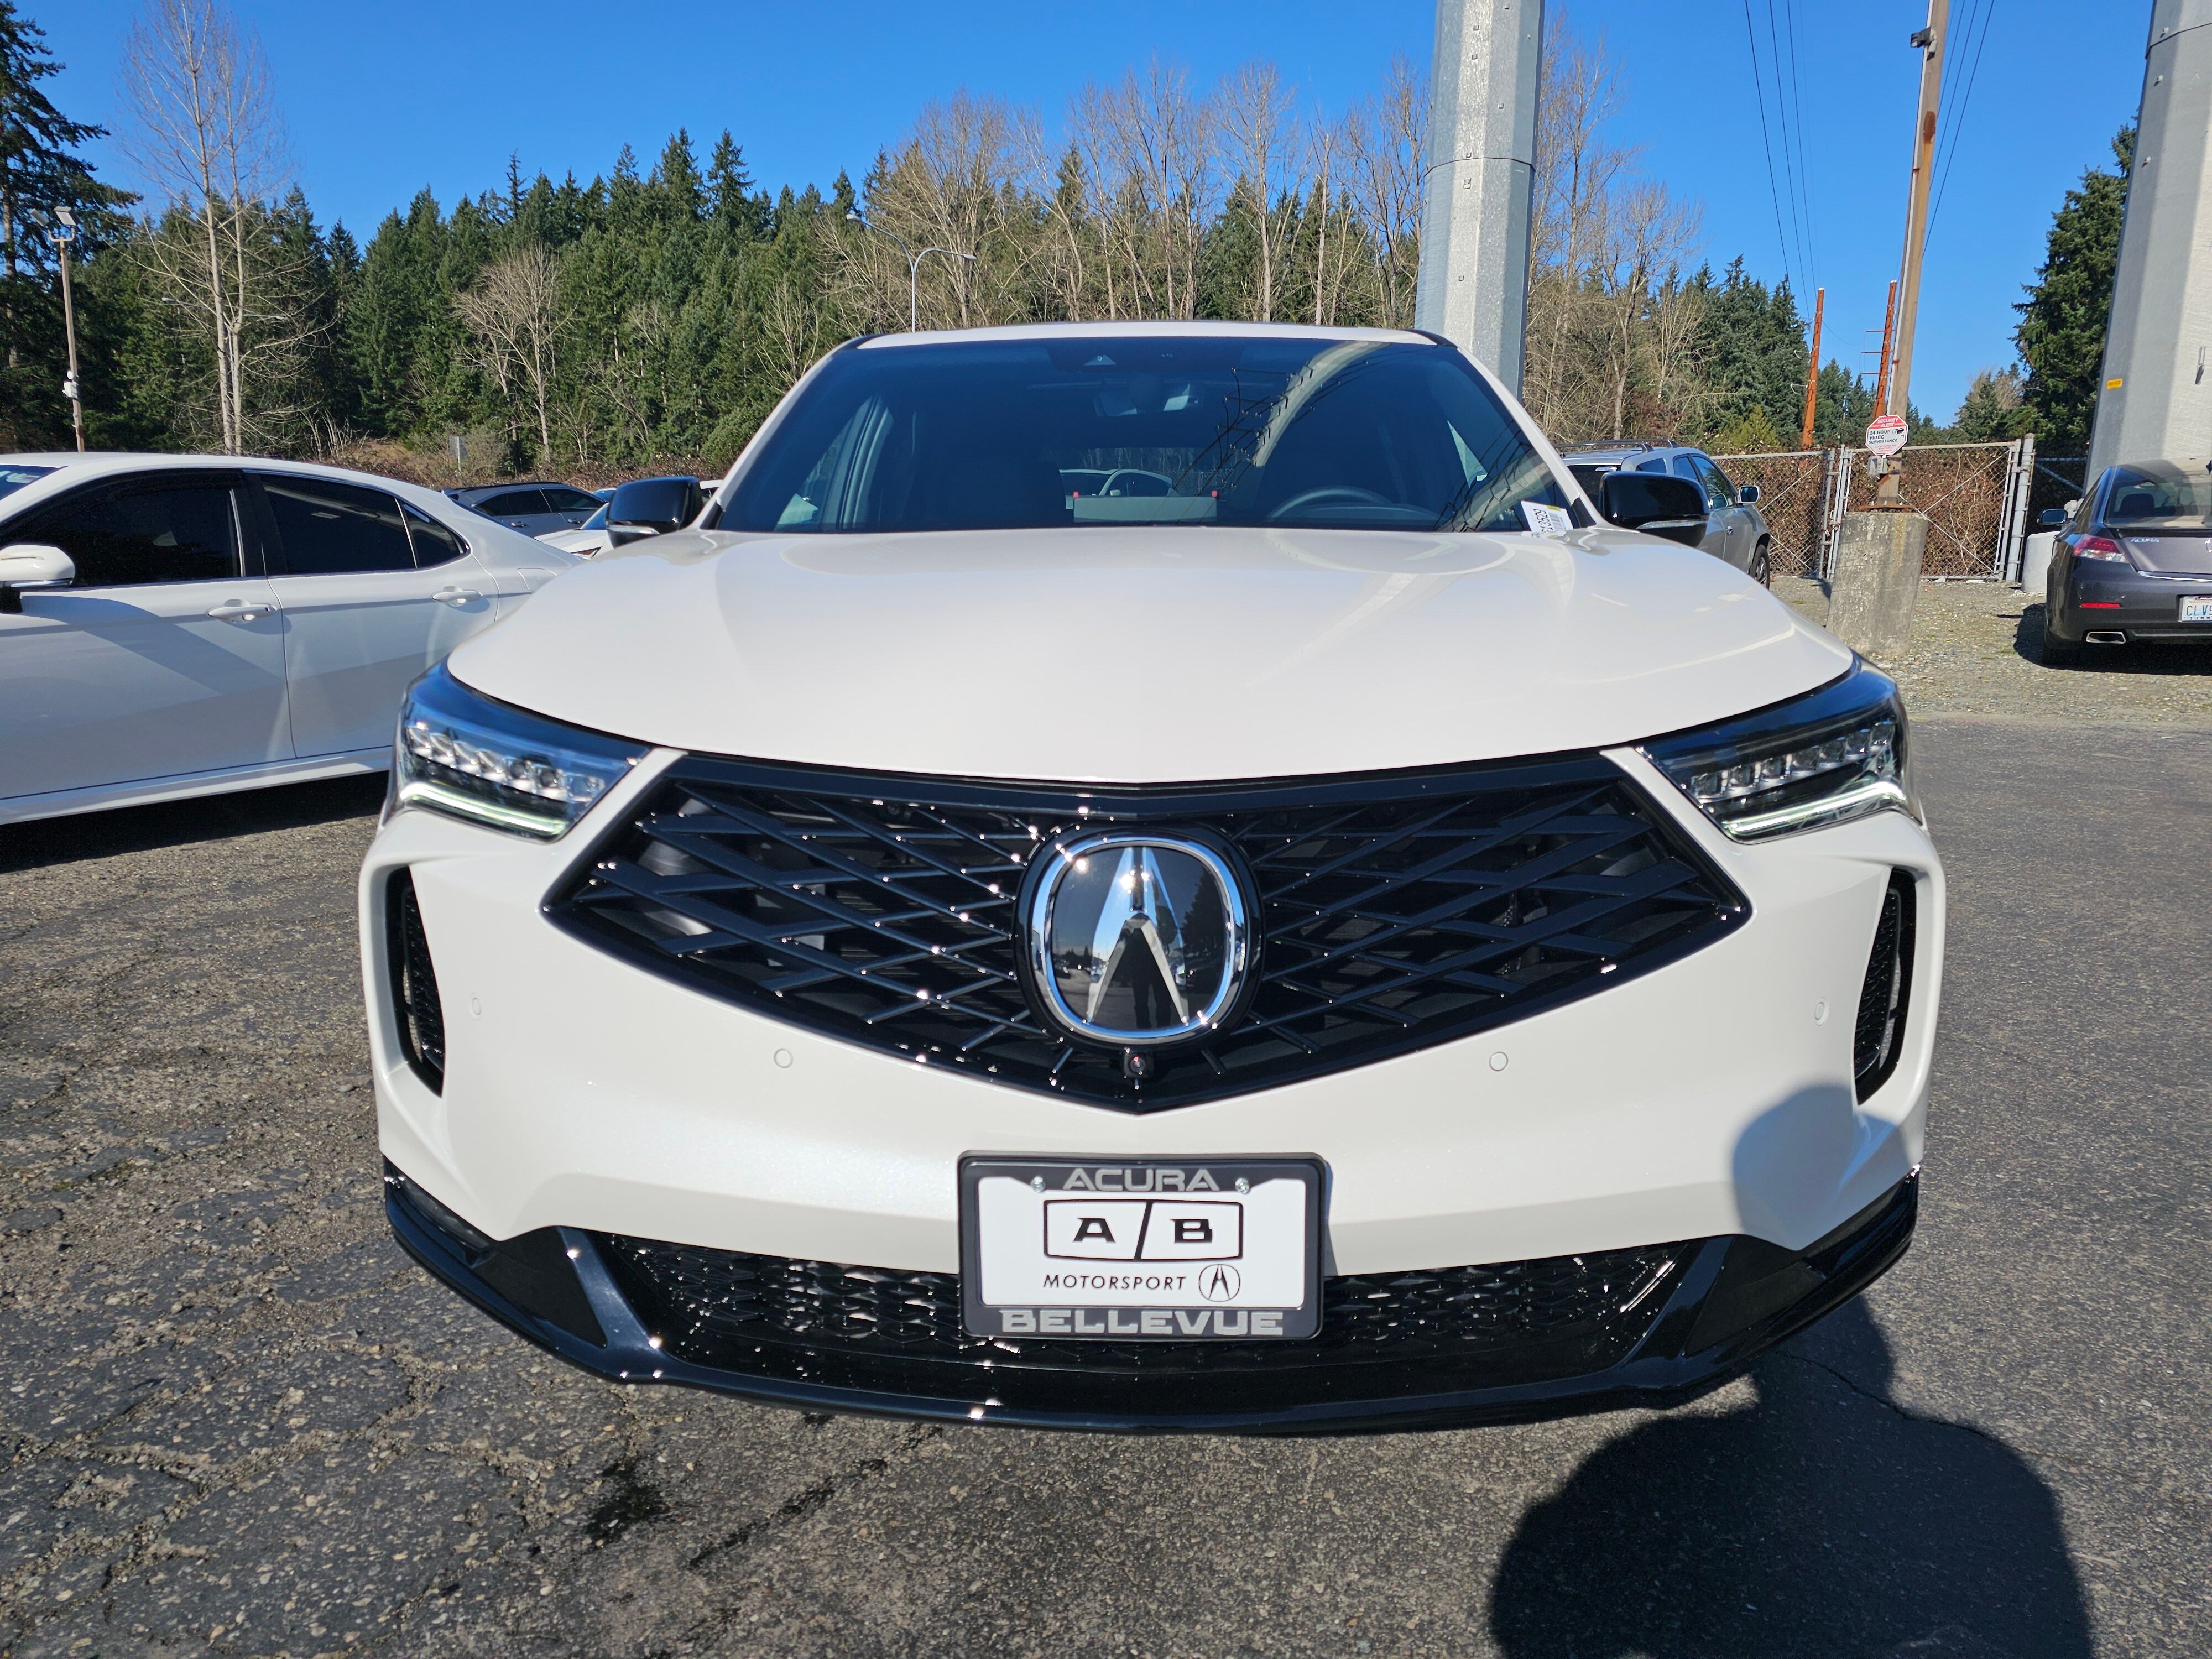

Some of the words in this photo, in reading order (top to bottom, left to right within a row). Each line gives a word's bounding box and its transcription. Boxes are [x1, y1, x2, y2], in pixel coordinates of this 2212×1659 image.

[1062, 1167, 1220, 1192] ACURA
[1043, 1274, 1186, 1290] MOTORSPORT
[999, 1308, 1284, 1337] BELLEVUE
